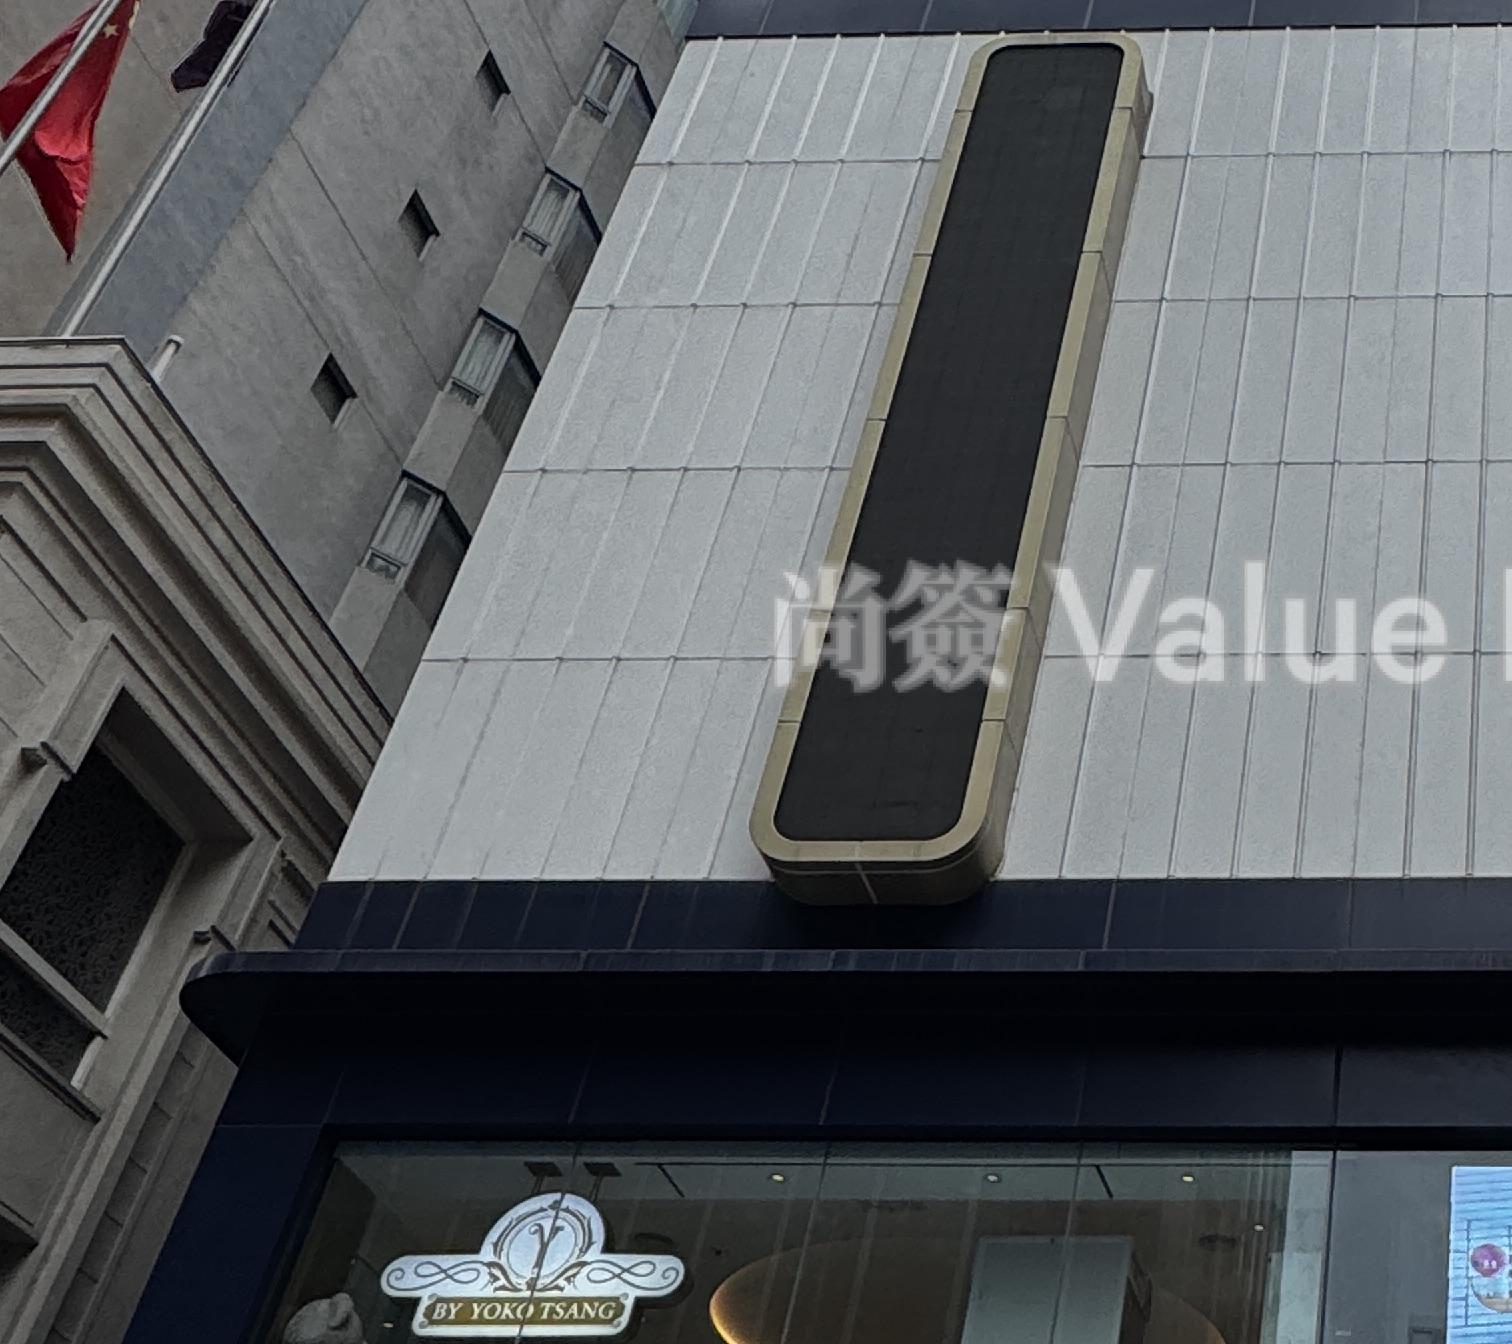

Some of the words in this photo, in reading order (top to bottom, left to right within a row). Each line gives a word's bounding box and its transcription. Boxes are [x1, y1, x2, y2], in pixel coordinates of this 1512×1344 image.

[431, 1301, 464, 1321] BY
[470, 1301, 535, 1321] YOKO
[539, 1301, 616, 1321] TSANG
